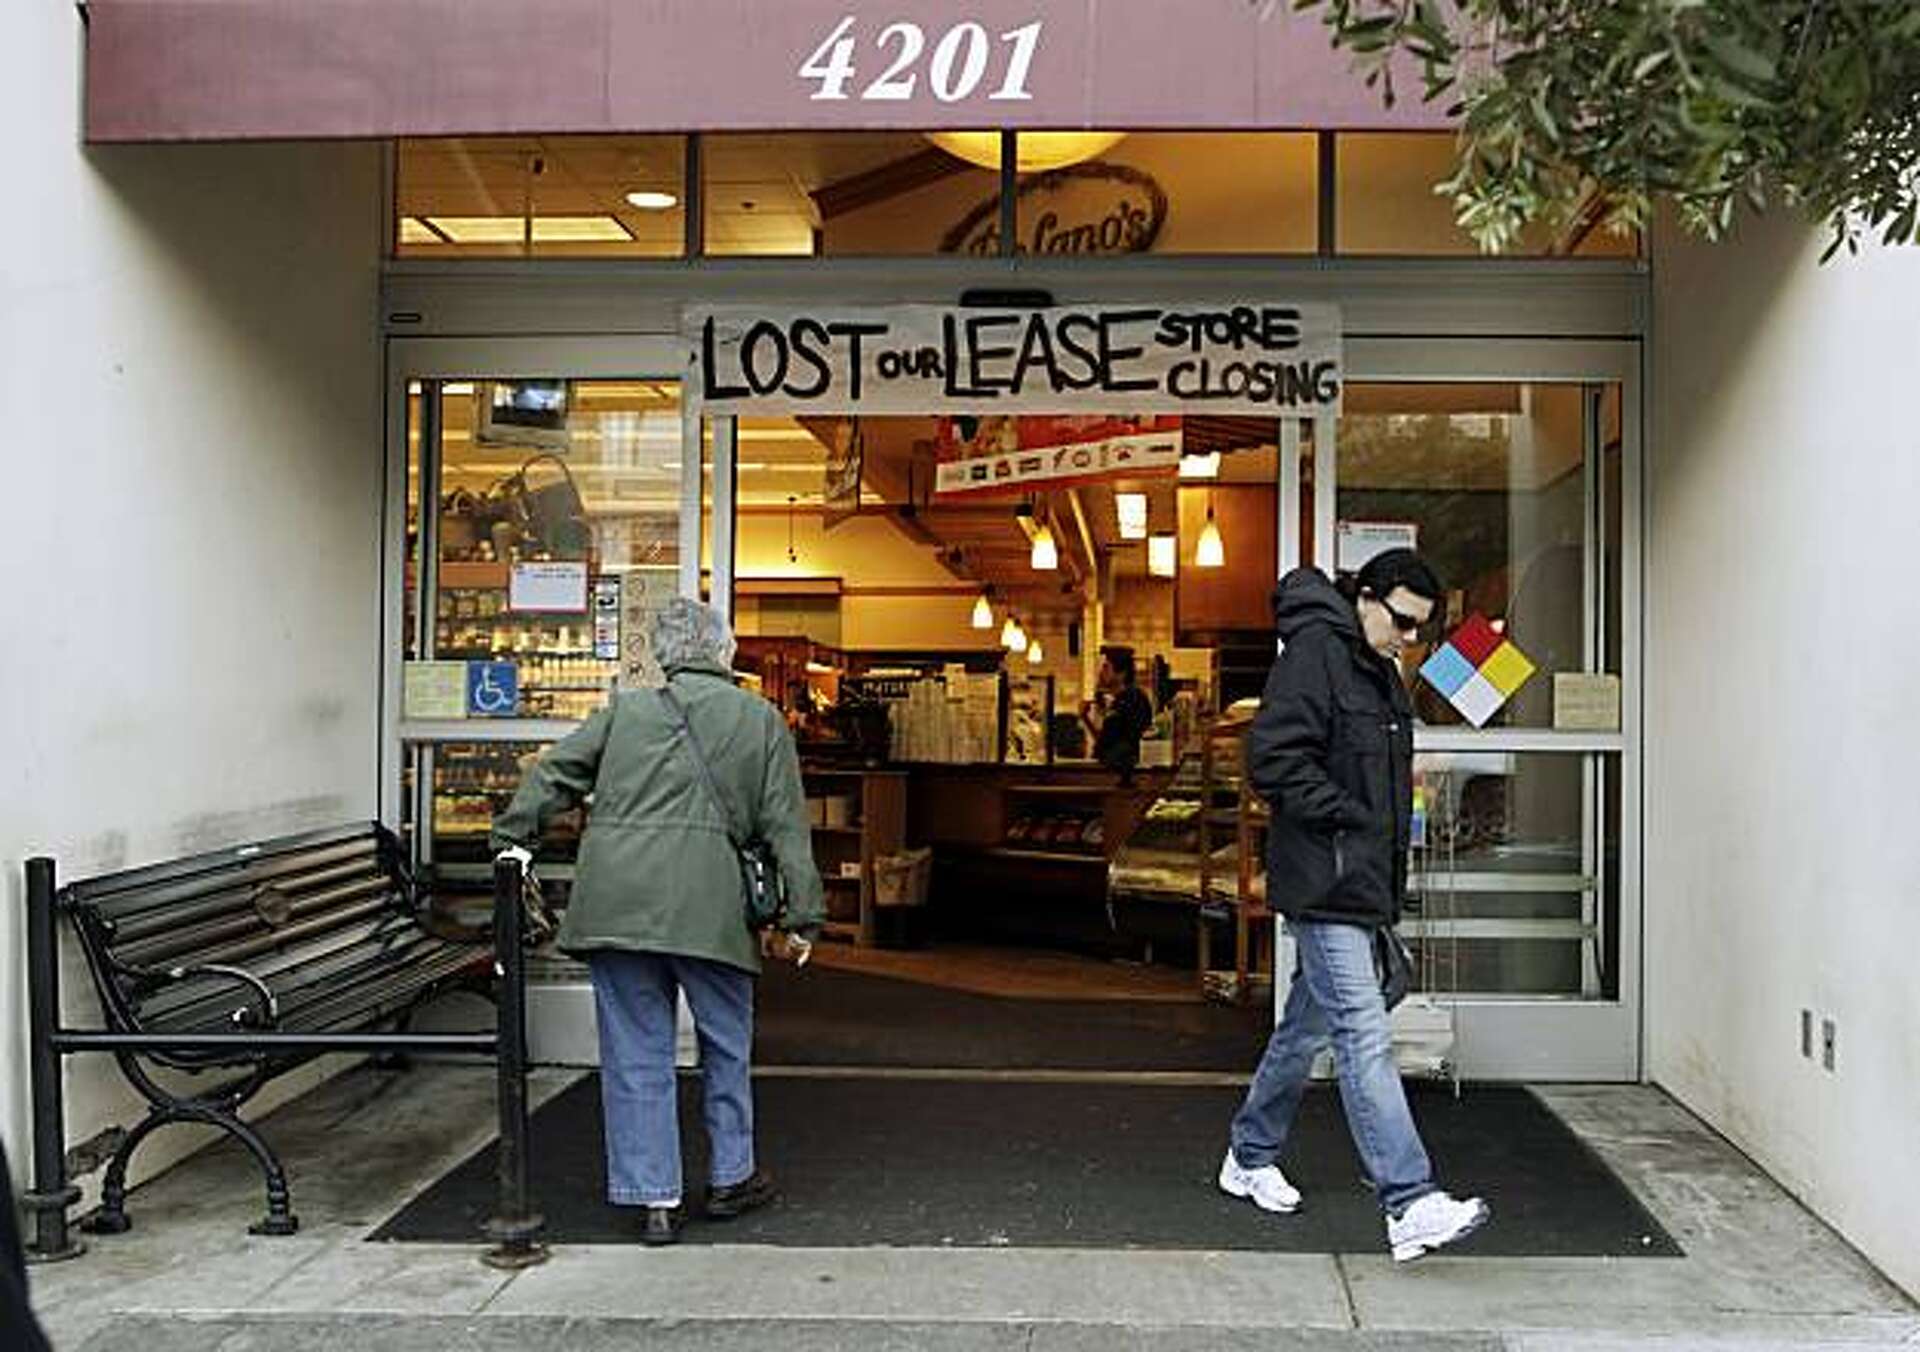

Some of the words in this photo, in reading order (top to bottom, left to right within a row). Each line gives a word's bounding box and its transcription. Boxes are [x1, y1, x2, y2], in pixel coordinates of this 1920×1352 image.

[799, 15, 1044, 102] 4201
[703, 315, 888, 401] LOST
[877, 347, 945, 379] OUR
[943, 312, 1163, 397] LEASE
[1154, 306, 1301, 352] STORE
[1167, 358, 1339, 407] CLOSING
